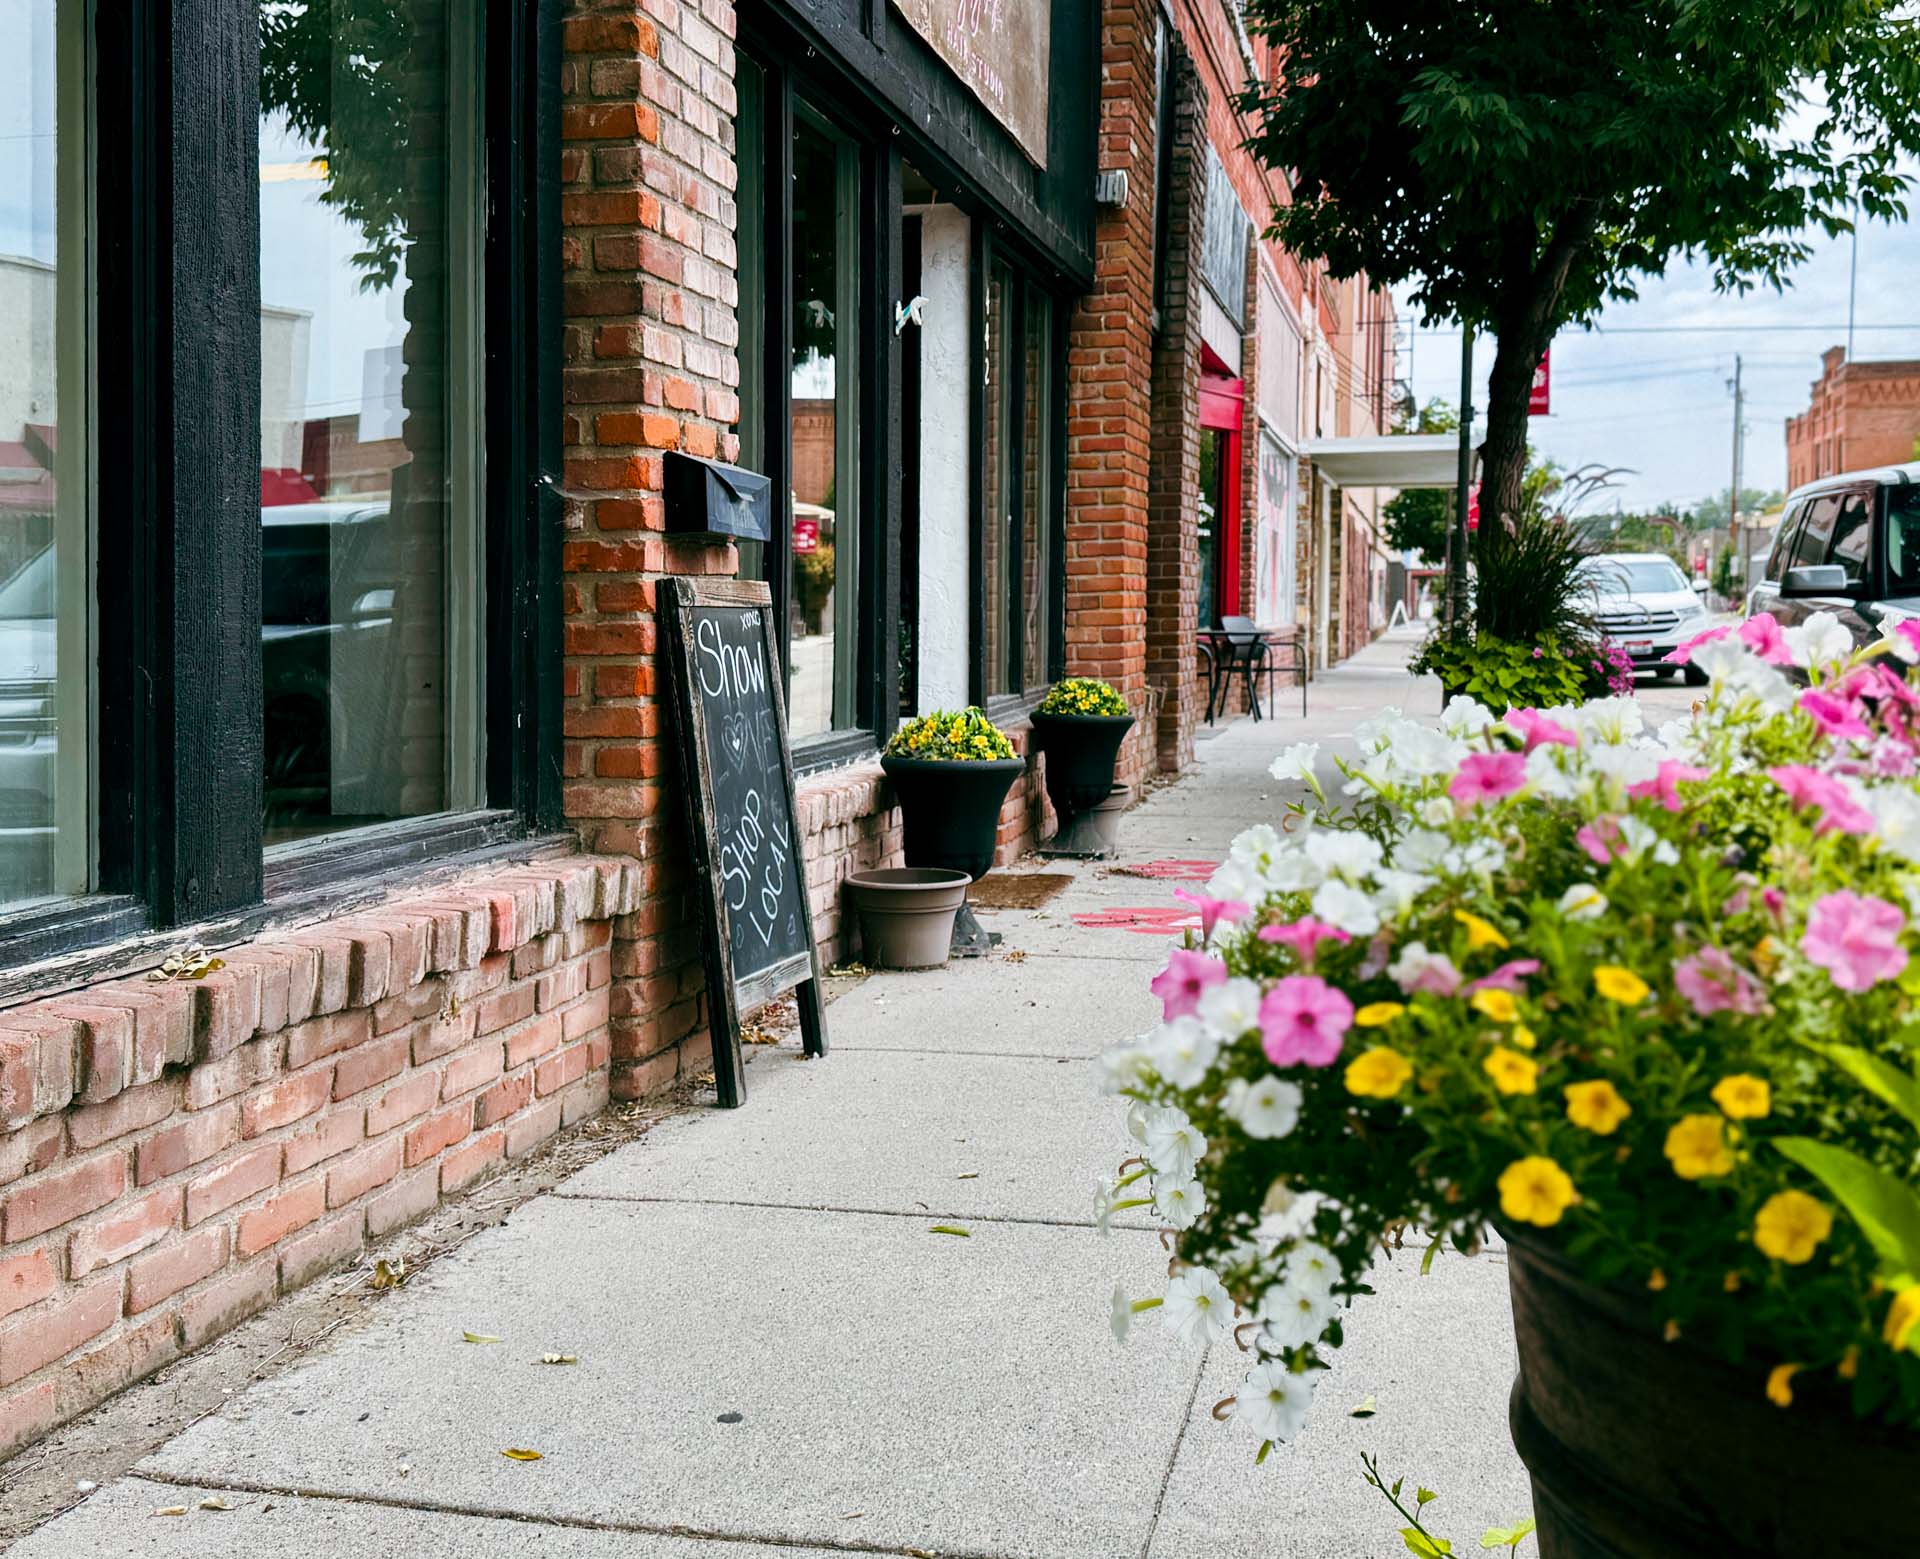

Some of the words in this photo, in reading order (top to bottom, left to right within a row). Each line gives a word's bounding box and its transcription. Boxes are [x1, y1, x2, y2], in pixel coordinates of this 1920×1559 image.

[697, 618, 765, 698] Show
[720, 789, 765, 911] SHOP
[749, 820, 789, 947] LOCAL
